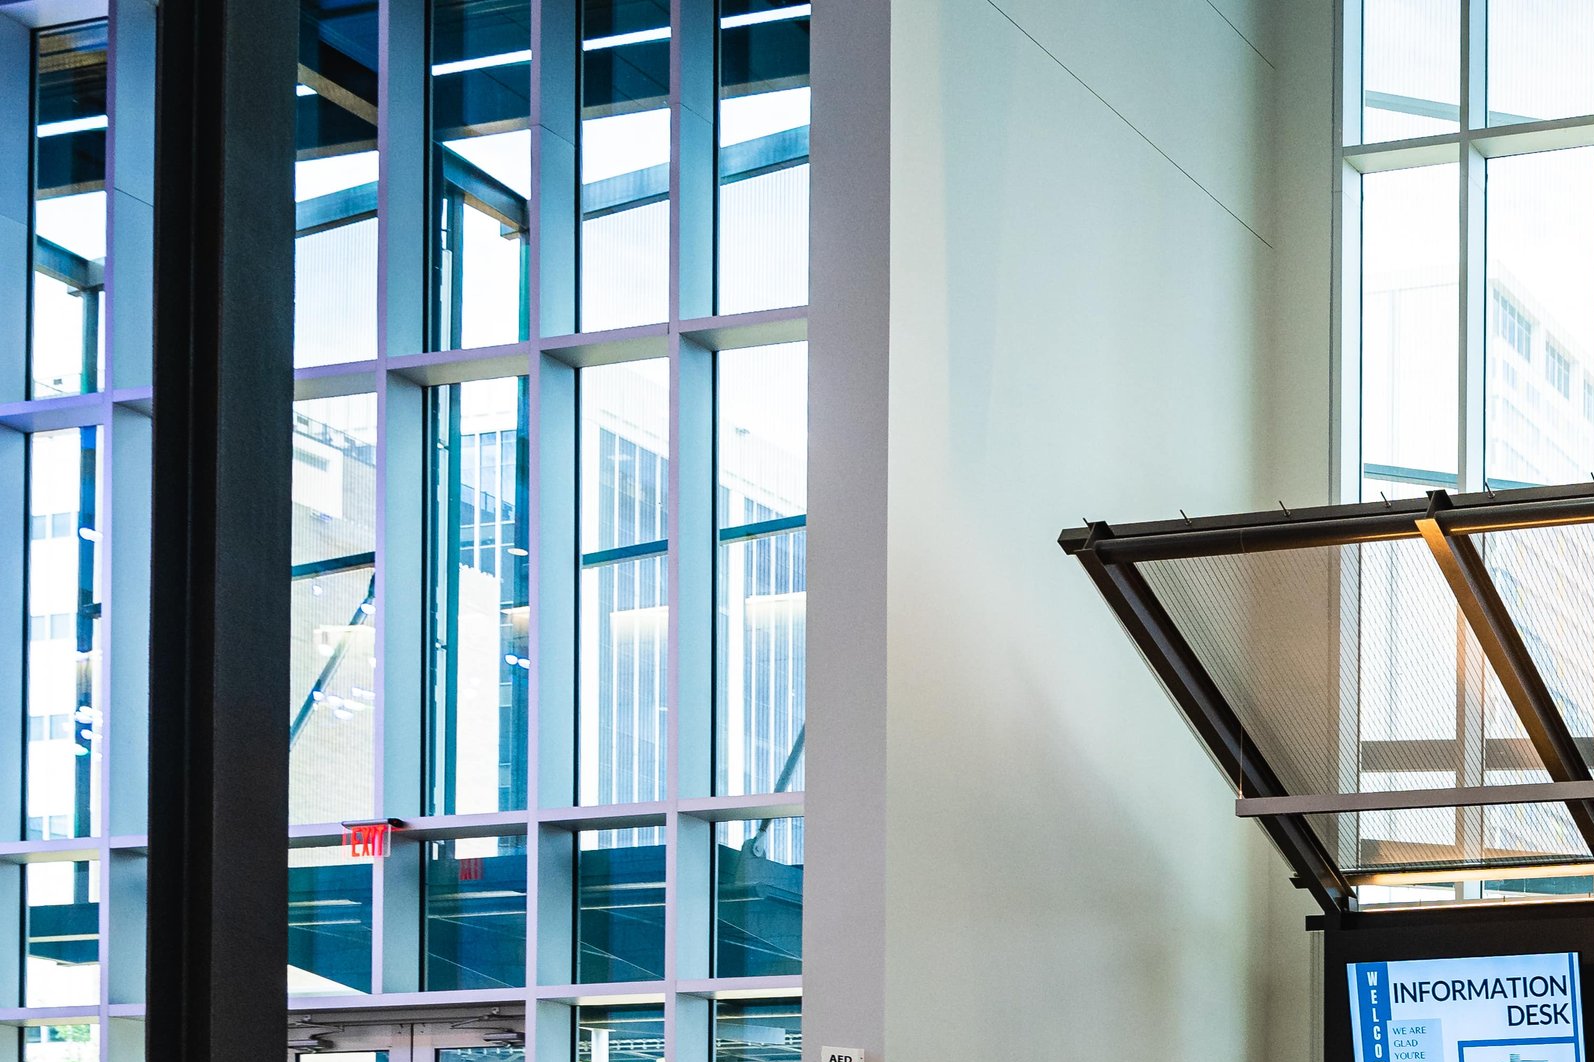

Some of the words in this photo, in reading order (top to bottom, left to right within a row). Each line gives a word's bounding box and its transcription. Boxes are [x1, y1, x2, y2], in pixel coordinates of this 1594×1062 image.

[351, 825, 385, 857] EXIT
[1393, 975, 1567, 1004] INFORMATION
[1507, 1003, 1571, 1026] DESK
[1392, 1027, 1407, 1035] WE
[1409, 1026, 1427, 1034] ARE
[1393, 1039, 1418, 1048] GLAD
[1394, 1051, 1426, 1060] YOU'RE
